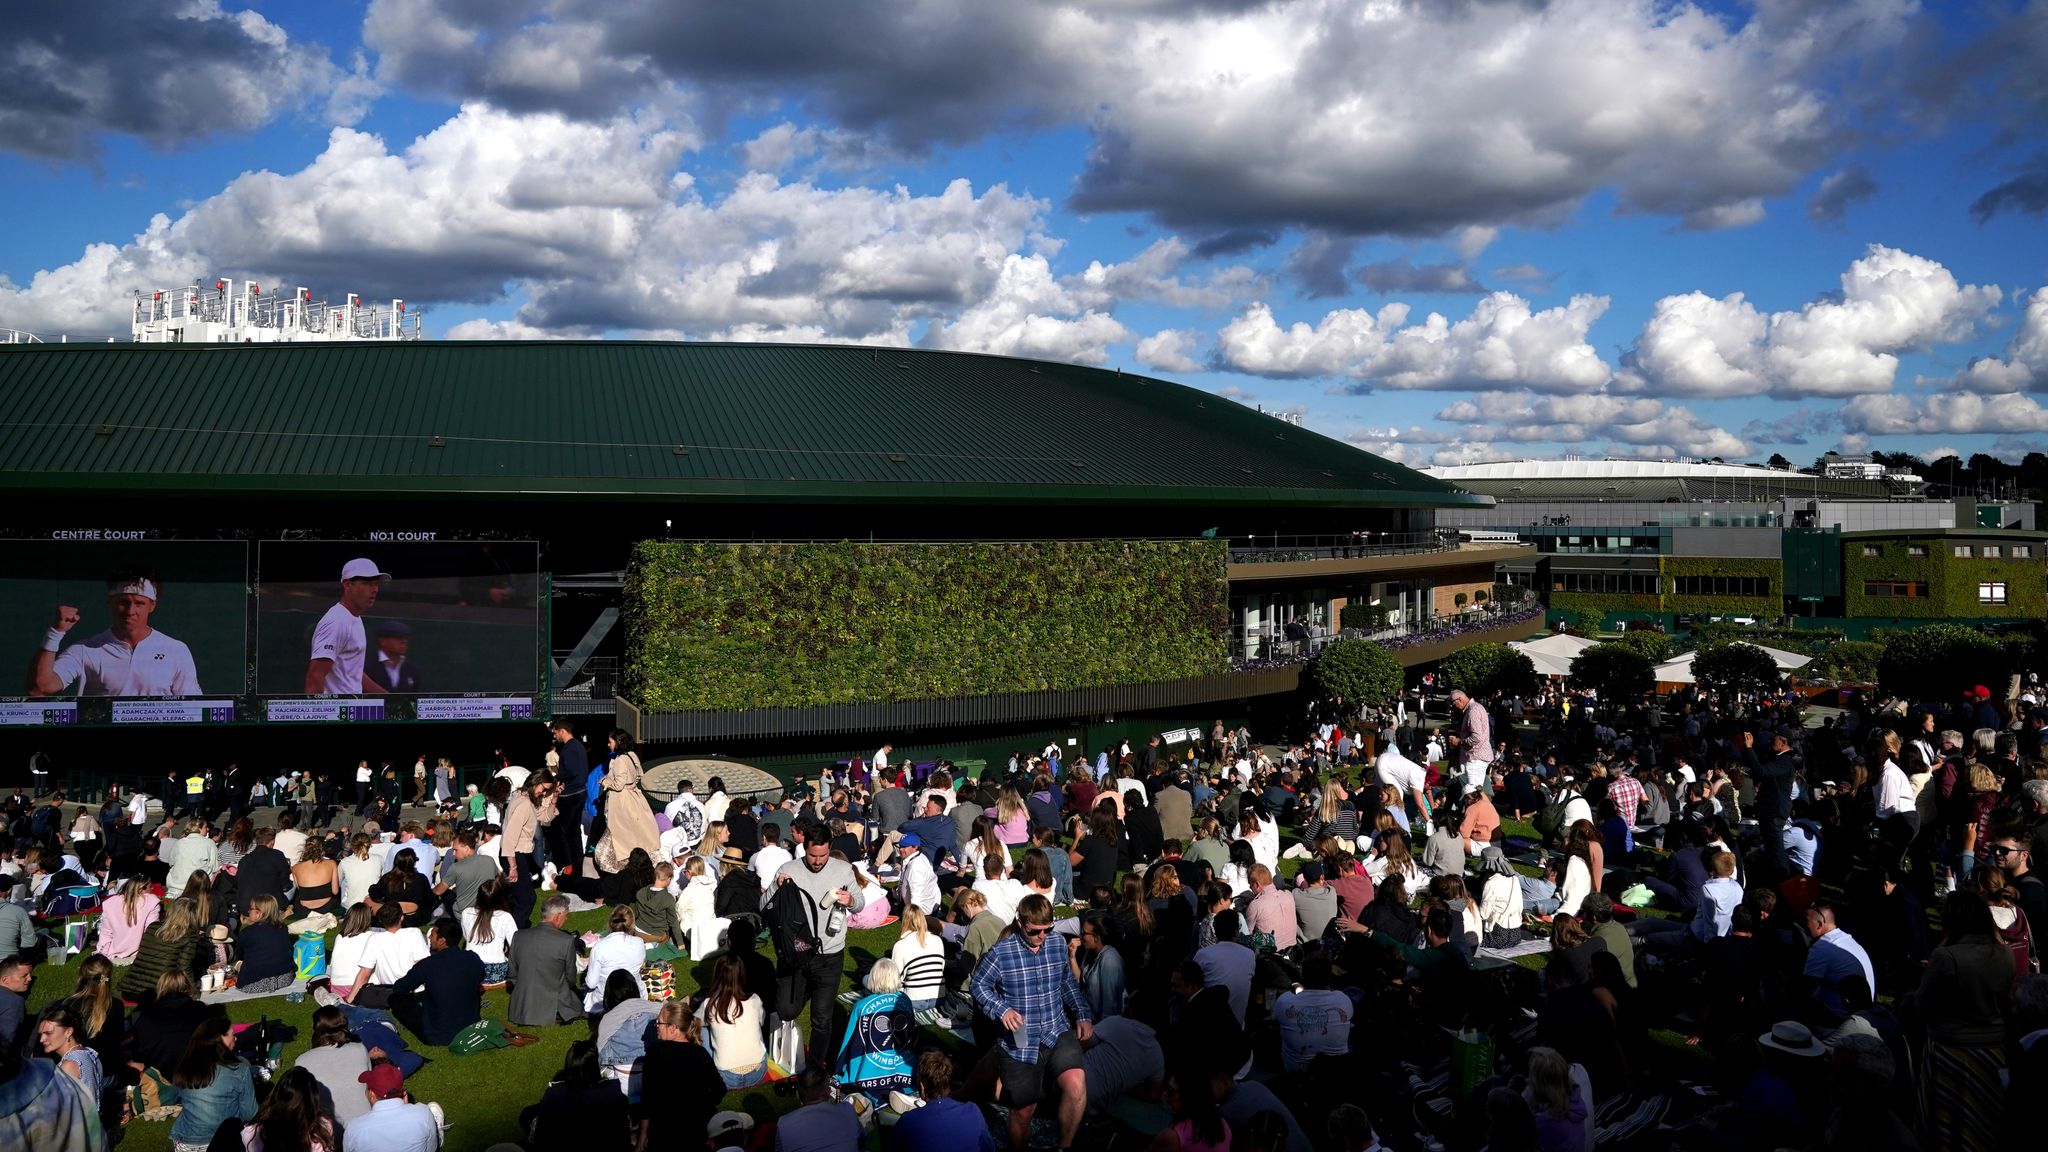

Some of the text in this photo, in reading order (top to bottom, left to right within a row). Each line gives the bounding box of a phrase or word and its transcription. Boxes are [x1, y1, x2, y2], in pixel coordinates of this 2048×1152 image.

[52, 530, 146, 540] CENTRE COURT
[370, 531, 437, 541] NO.1 COURT
[879, 1077, 891, 1086] OF
